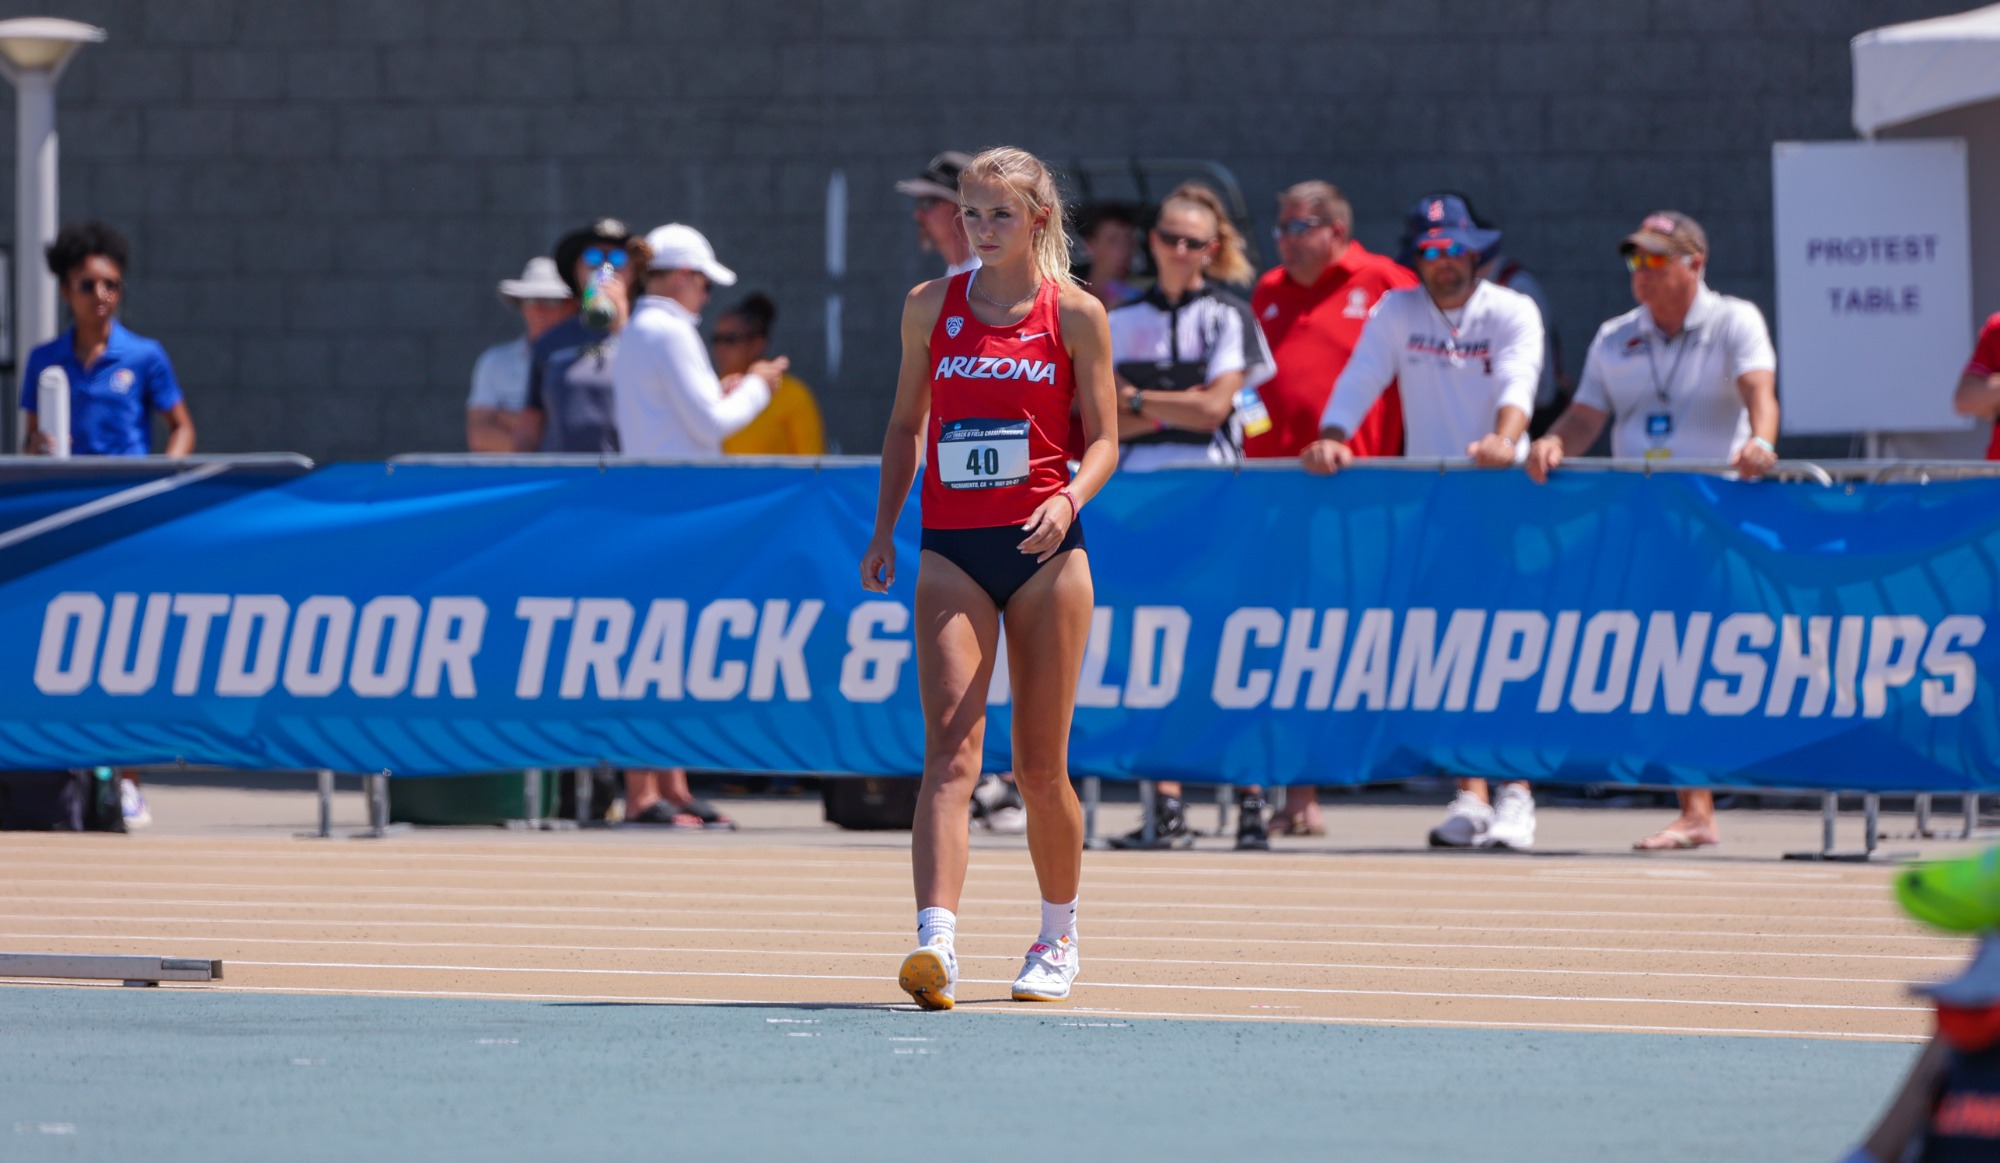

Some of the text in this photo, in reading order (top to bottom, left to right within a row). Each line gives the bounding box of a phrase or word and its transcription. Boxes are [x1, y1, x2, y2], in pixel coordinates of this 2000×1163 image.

[1807, 234, 1939, 265] PROTEST
[1828, 286, 1920, 315] TABLE
[935, 356, 1057, 385] ARIZONA
[966, 448, 999, 475] 40
[33, 591, 489, 698] OUTDOOR
[515, 596, 825, 701] TRACK
[839, 600, 912, 702] &
[1210, 606, 1986, 719] CHAMPIONSHIPS
